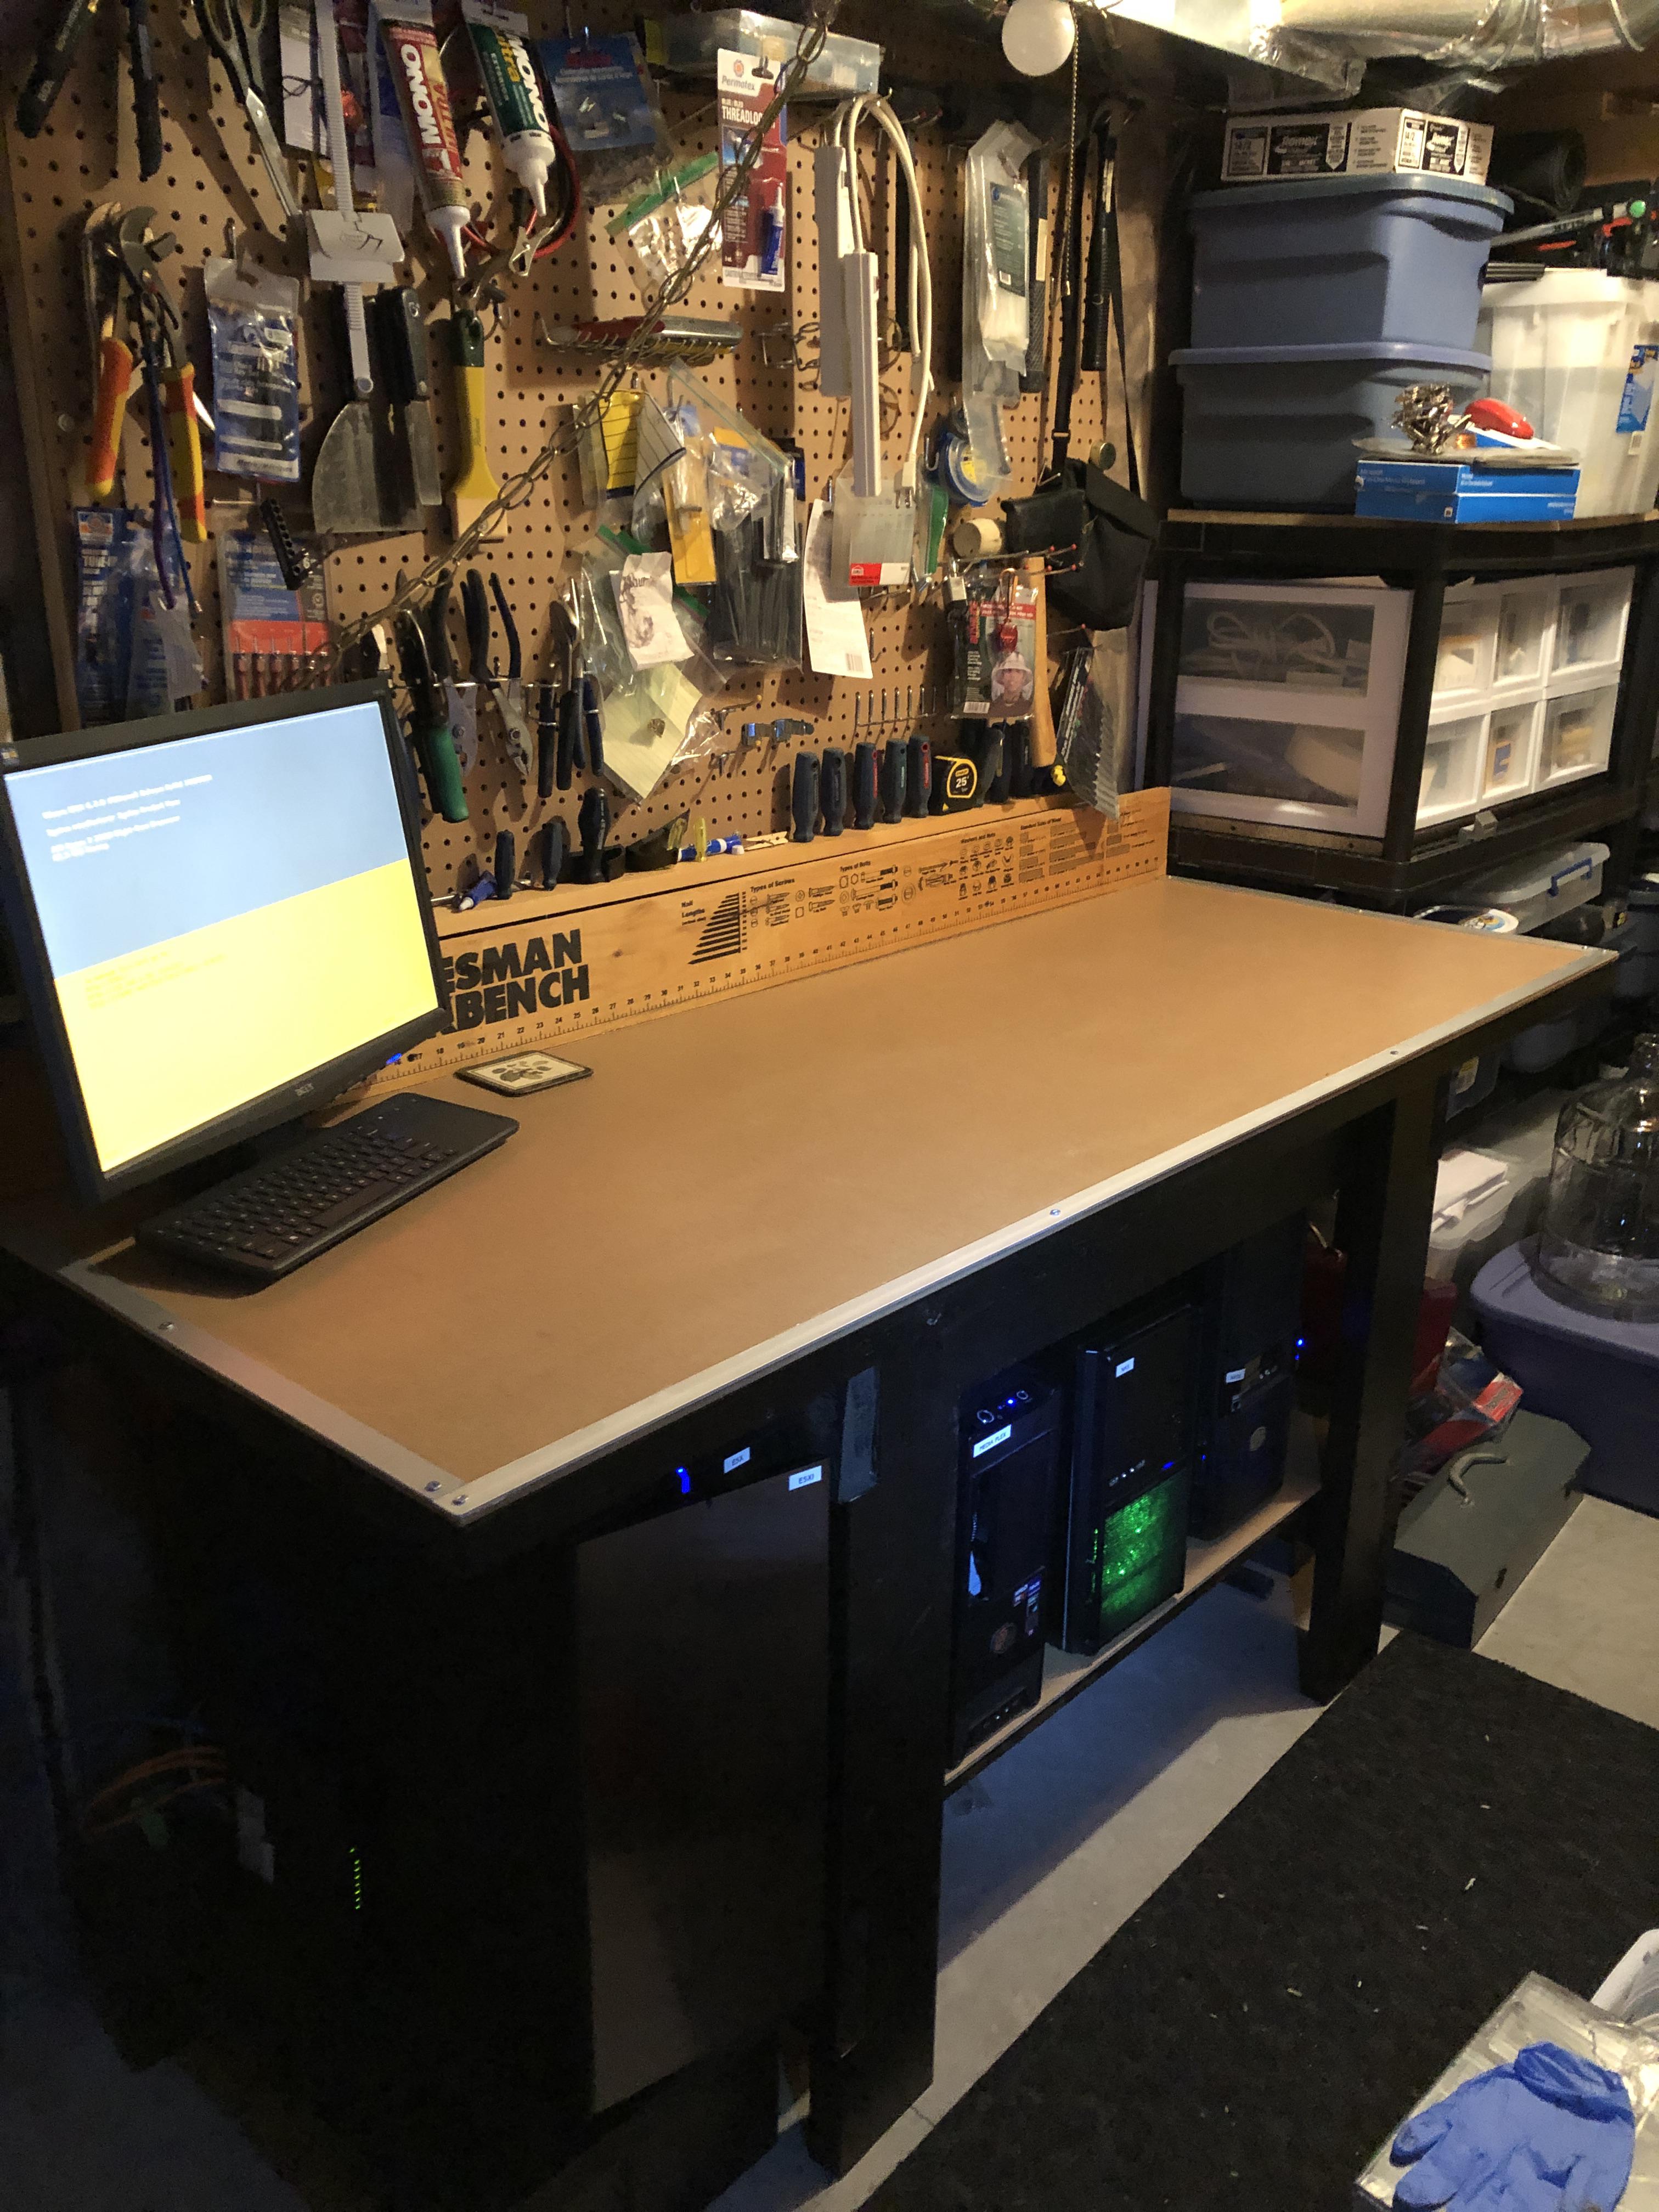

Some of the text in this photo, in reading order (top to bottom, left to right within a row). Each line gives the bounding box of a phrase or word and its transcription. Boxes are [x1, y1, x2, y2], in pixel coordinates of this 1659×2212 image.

[506, 33, 550, 132] MONO
[721, 75, 756, 92] Permatex
[400, 43, 443, 145] MONO
[750, 884, 766, 893] Types
[775, 878, 795, 887] Screws
[681, 909, 706, 918] Lengths
[731, 1455, 743, 1466] ESX
